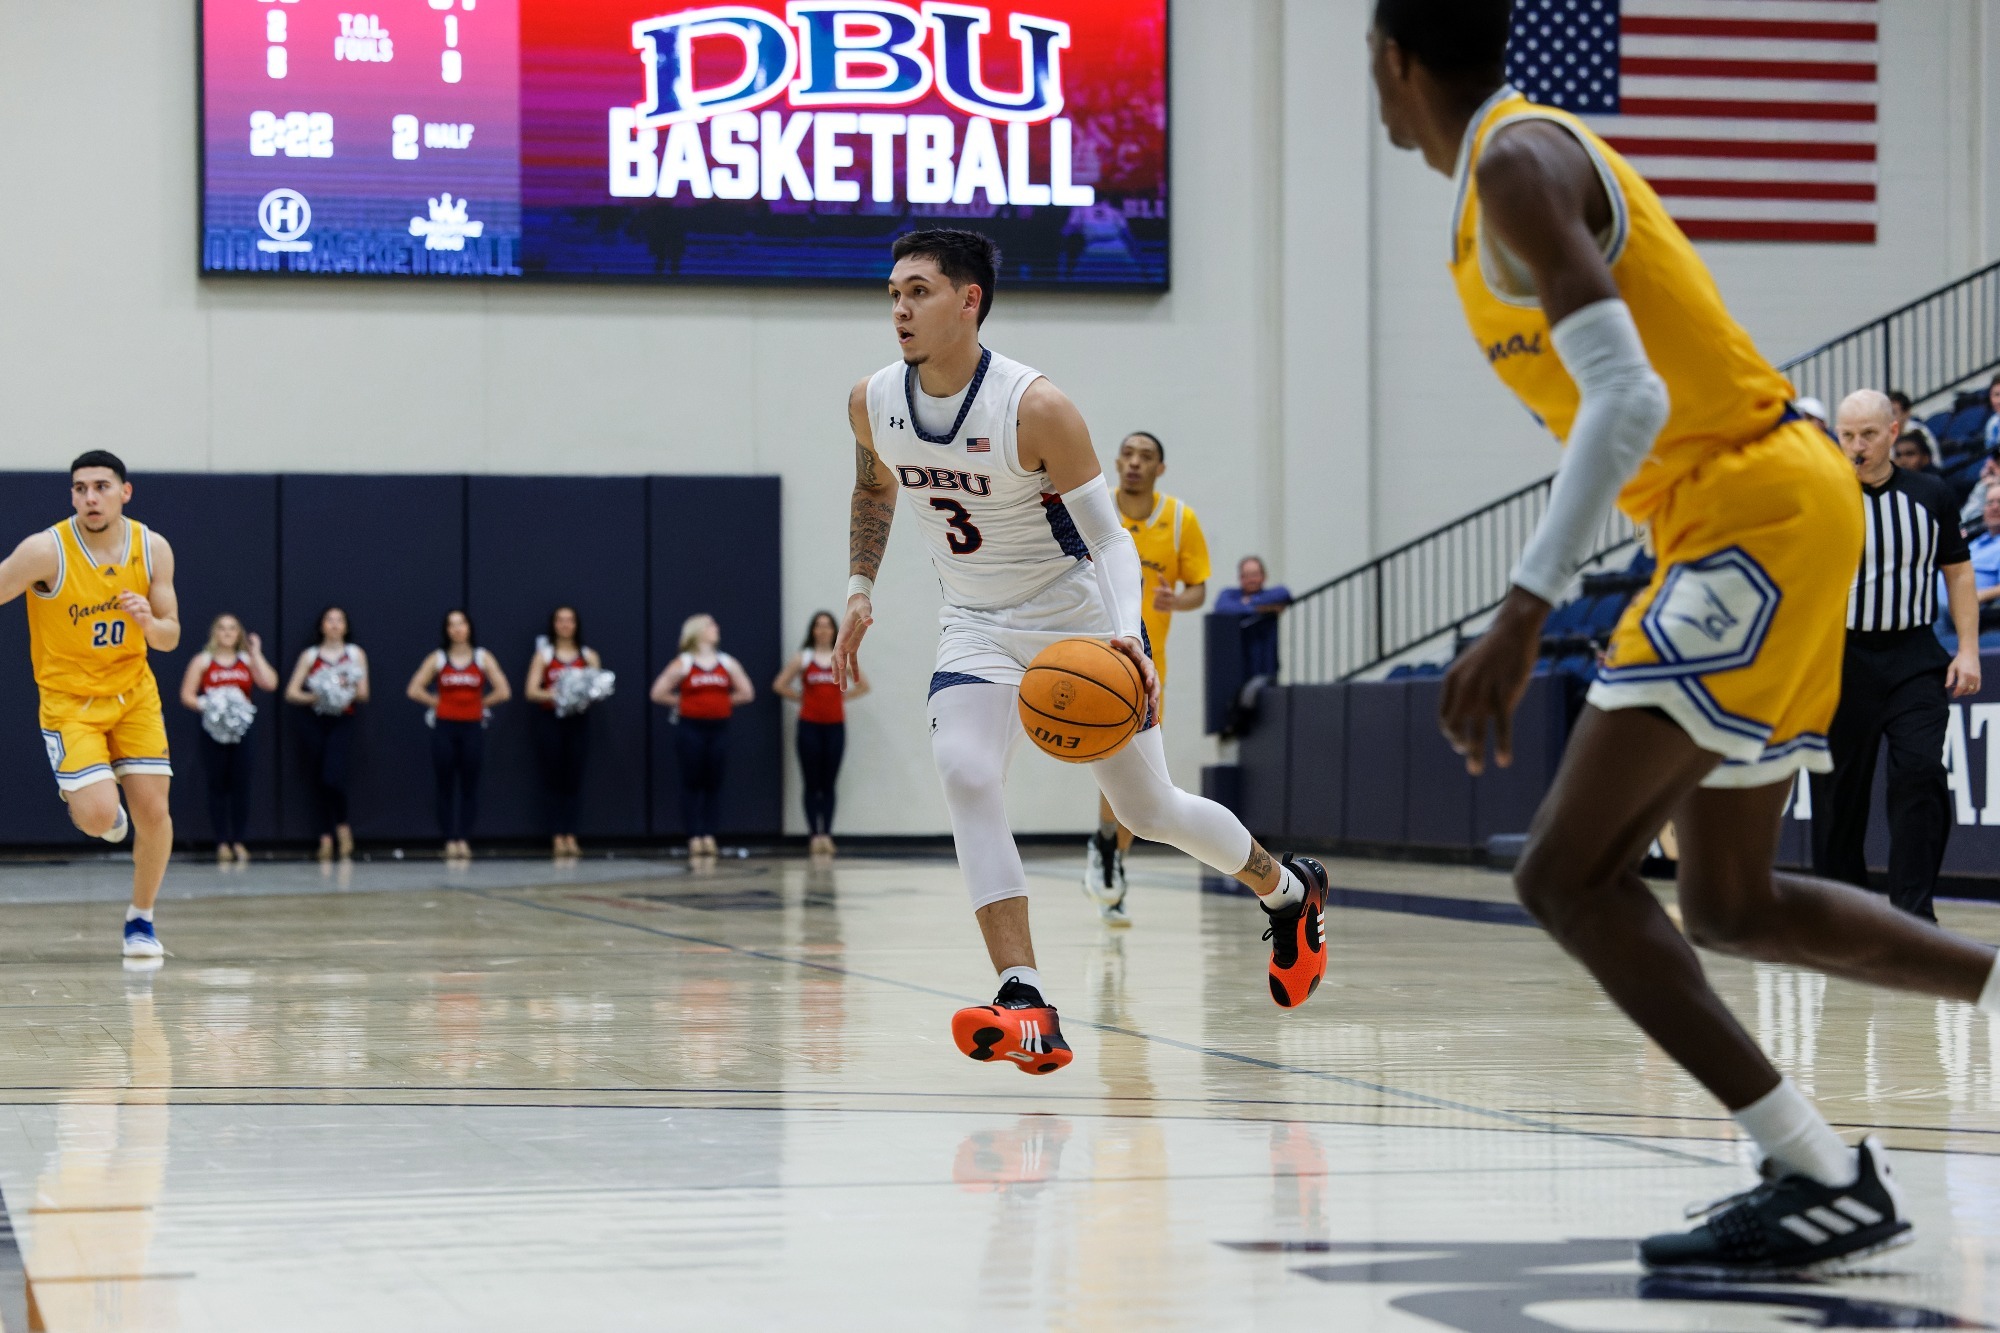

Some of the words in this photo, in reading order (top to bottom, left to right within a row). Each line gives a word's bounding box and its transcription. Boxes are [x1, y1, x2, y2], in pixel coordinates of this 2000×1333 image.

[632, 0, 1071, 129] DBU
[250, 111, 333, 157] 2:22
[392, 114, 419, 160] 2
[424, 123, 474, 149] HALF
[608, 107, 1095, 206] BASKETBALL
[896, 465, 991, 497] DBU
[930, 497, 983, 554] 3
[92, 619, 125, 648] 20
[1034, 726, 1081, 749] EVO
